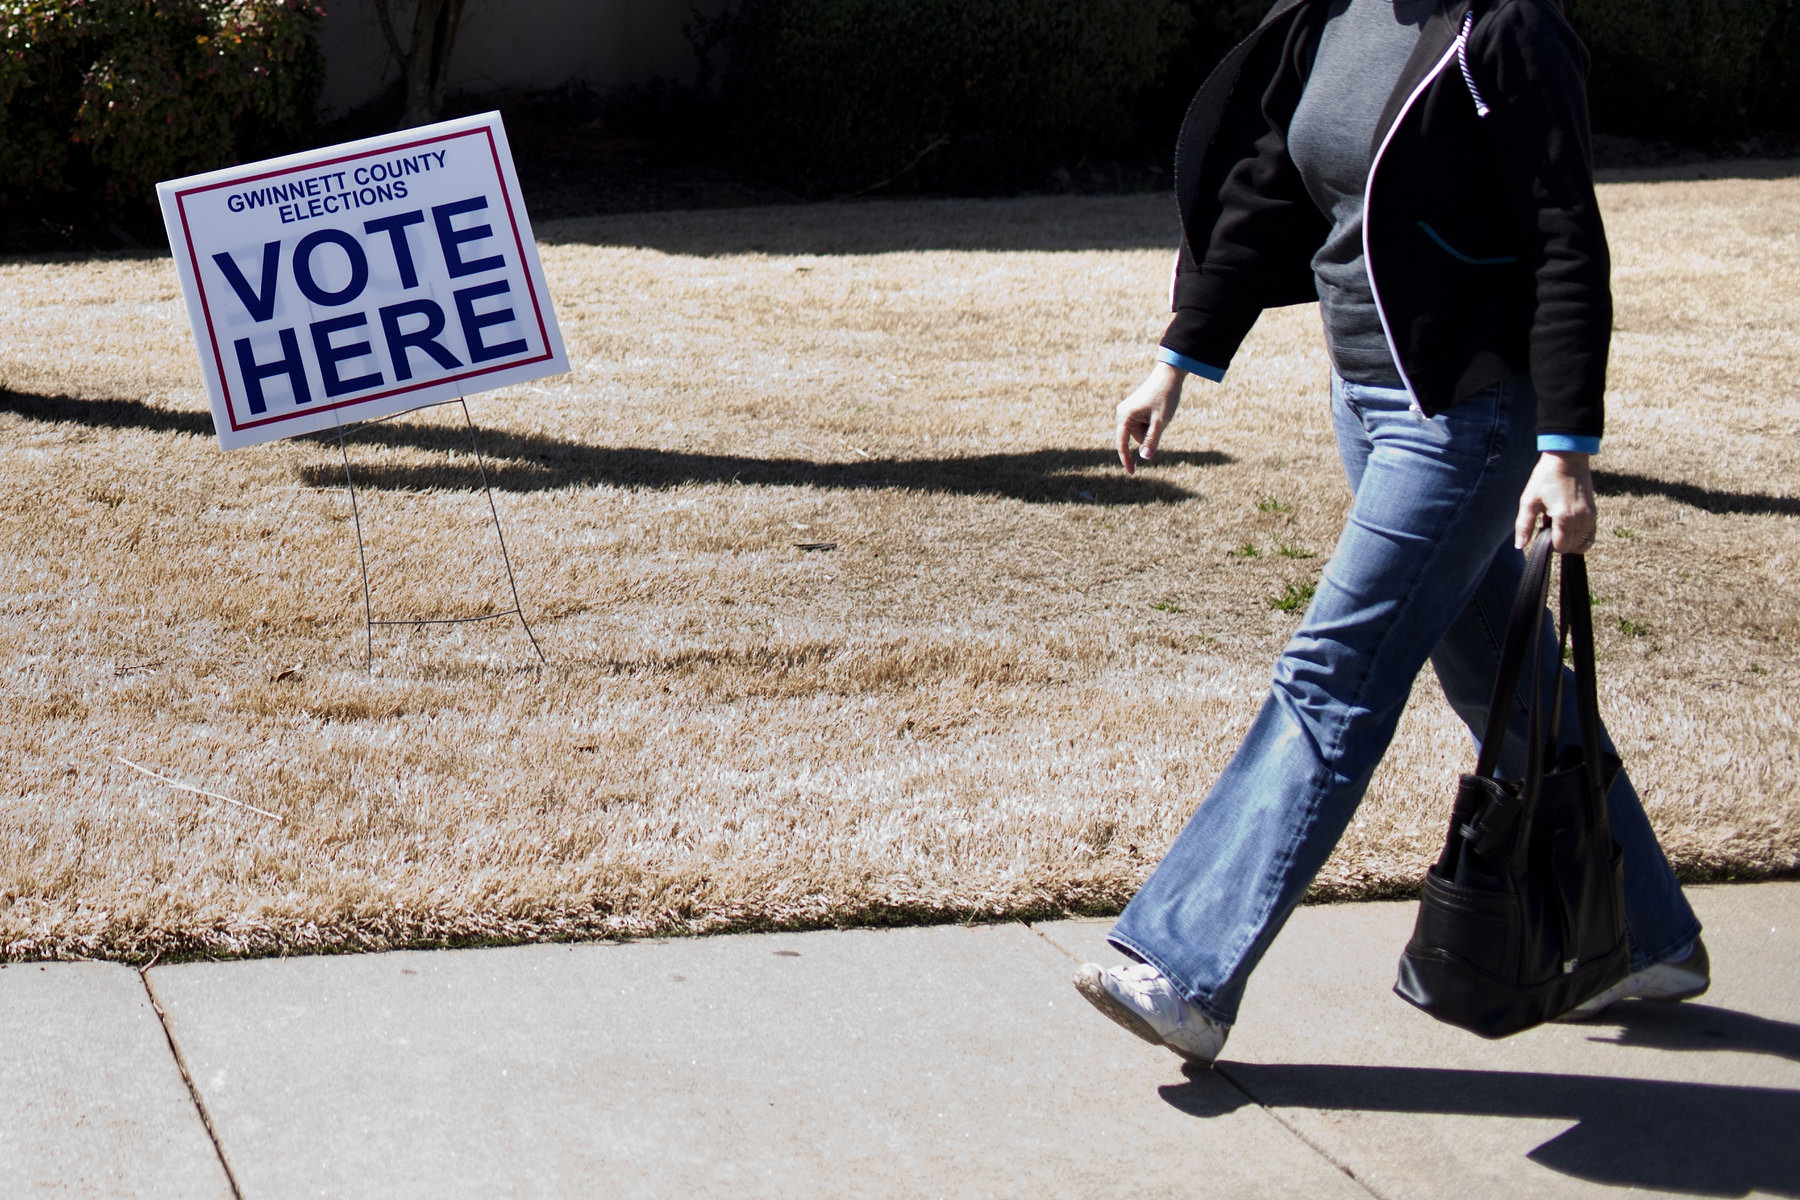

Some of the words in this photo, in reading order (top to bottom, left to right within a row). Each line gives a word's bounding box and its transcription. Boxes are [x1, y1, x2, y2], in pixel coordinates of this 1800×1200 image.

[227, 172, 346, 213] GWINNETT
[353, 150, 447, 183] COUNTY
[278, 180, 409, 224] ELECTIONS
[212, 195, 506, 323] VOTE
[233, 279, 529, 415] HERE
